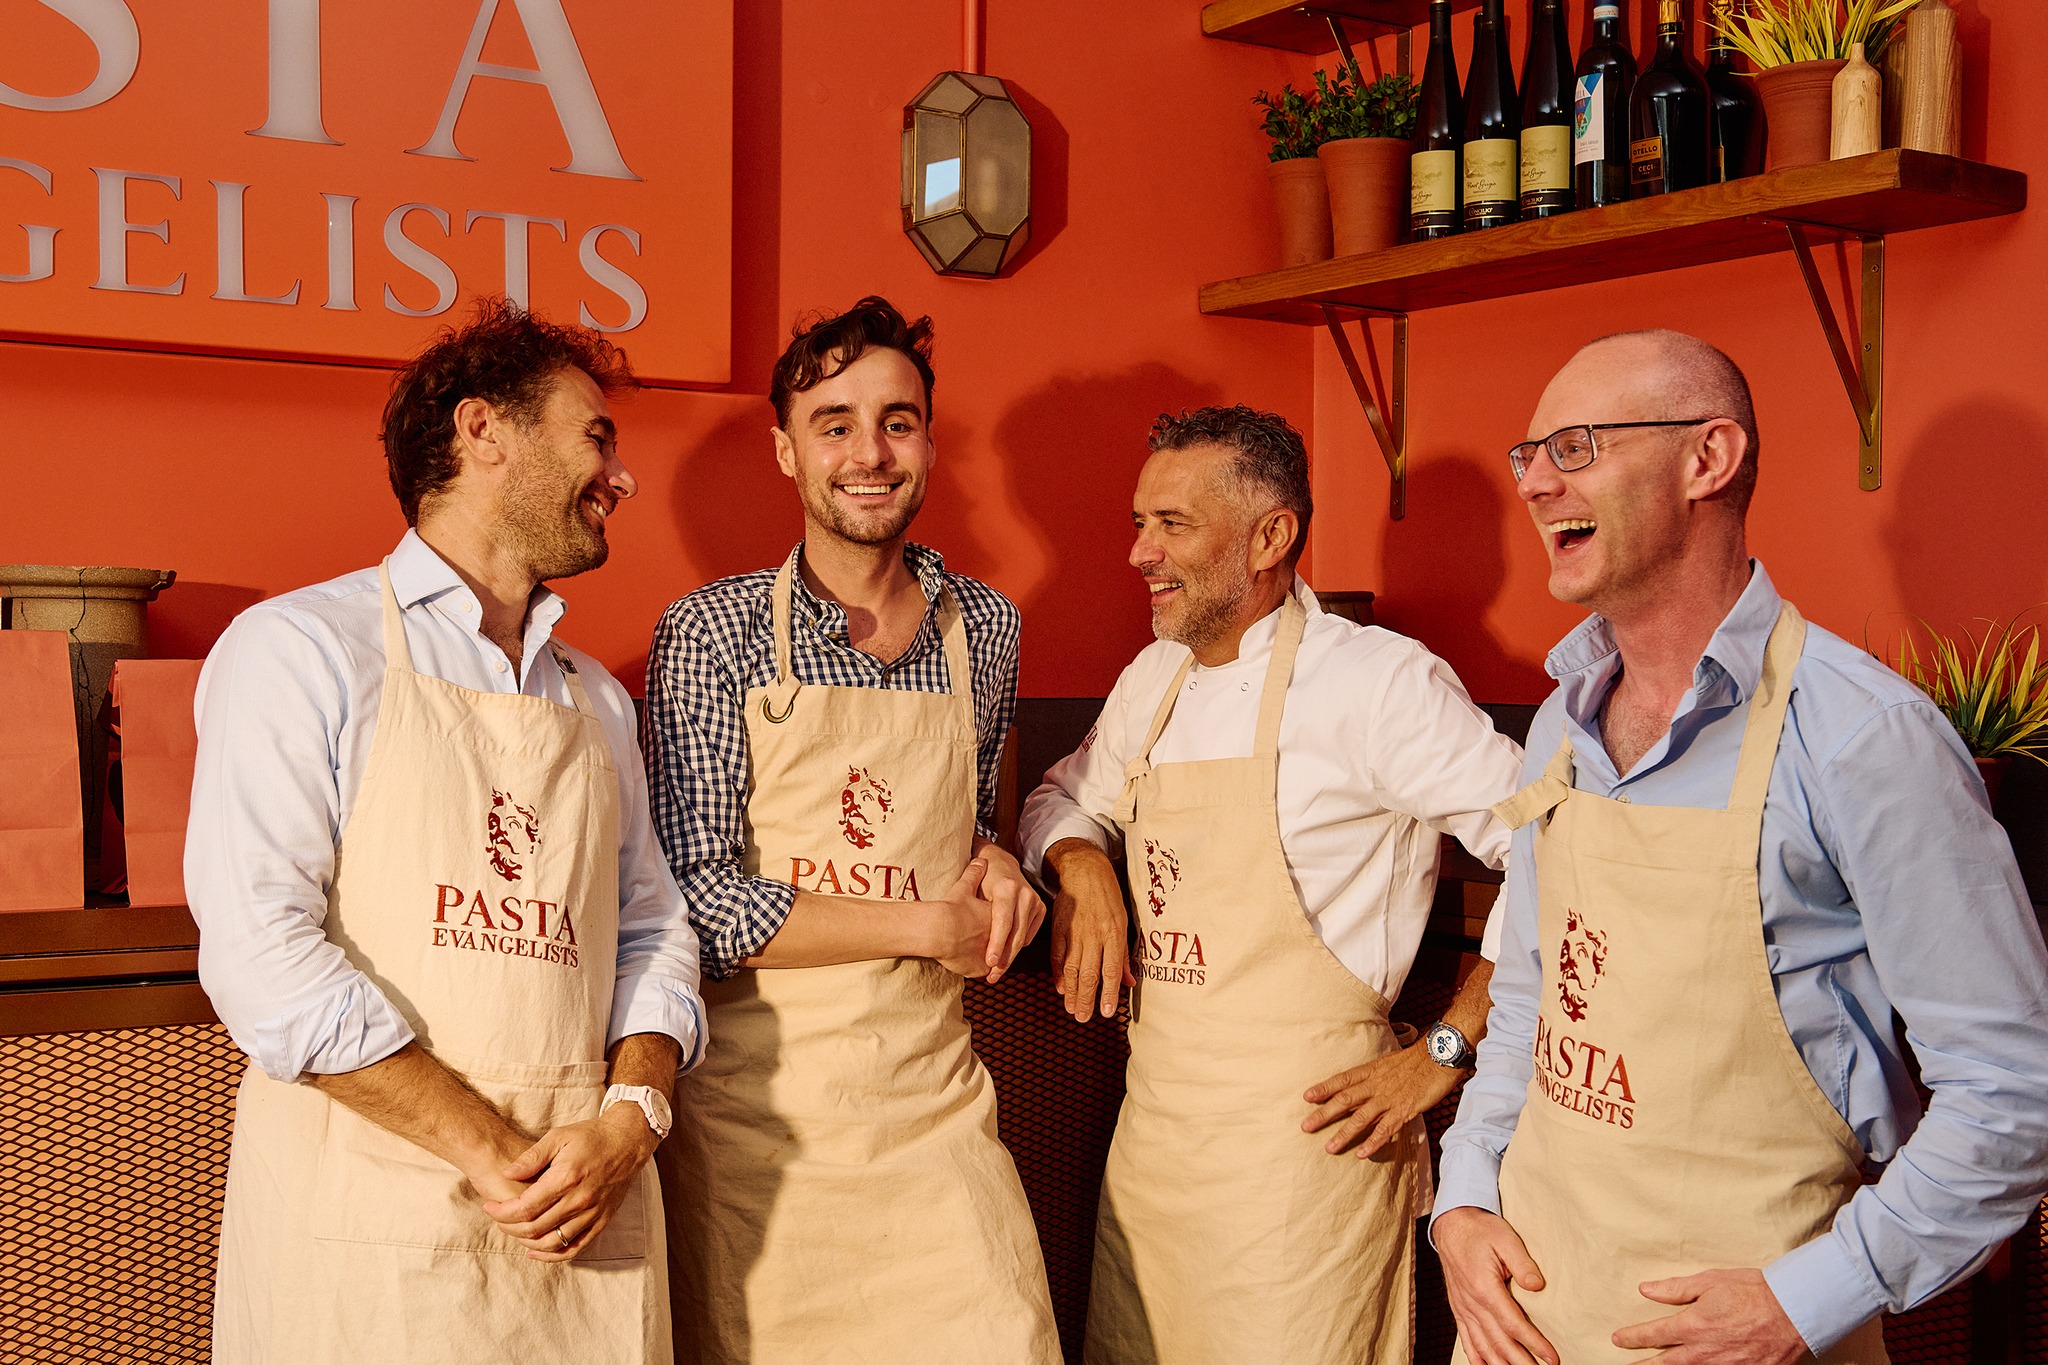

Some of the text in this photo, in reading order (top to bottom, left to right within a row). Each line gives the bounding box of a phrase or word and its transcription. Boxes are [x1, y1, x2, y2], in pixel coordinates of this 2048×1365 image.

[1633, 145, 1658, 156] OTELLO
[0, 157, 648, 332] GELISTS
[789, 856, 922, 902] PASTA
[433, 883, 578, 946] PASTA
[432, 927, 578, 968] EVANGELISTS
[1132, 961, 1206, 985] ANGELISTS
[1534, 1014, 1636, 1104] PASTA
